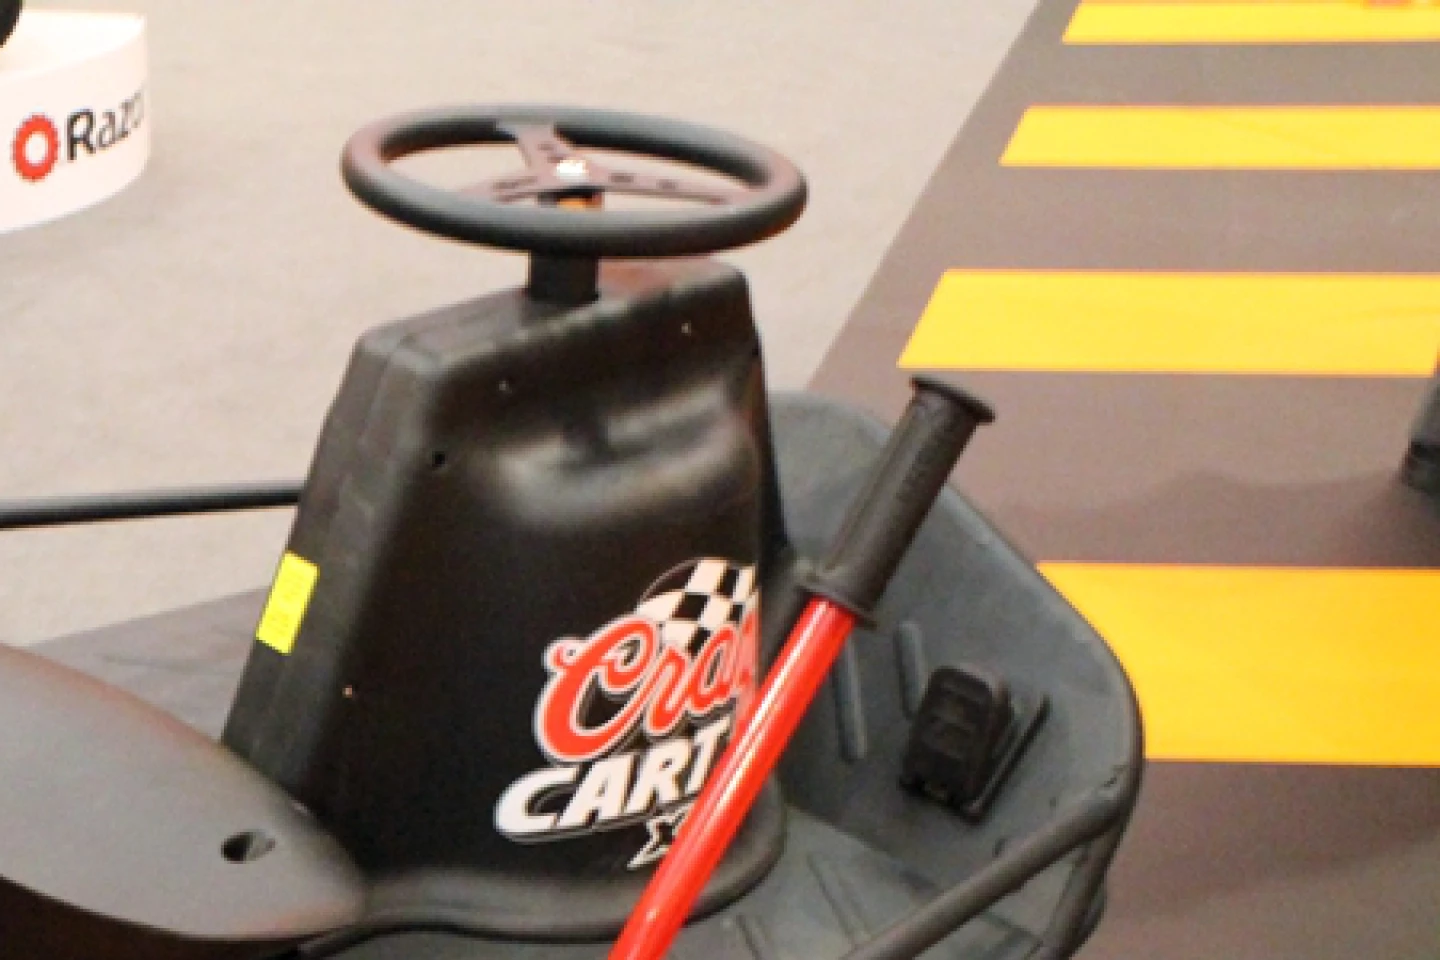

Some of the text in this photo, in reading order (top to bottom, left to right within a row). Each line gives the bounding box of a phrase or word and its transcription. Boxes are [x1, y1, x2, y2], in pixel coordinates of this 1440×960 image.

[65, 91, 146, 162] Razo
[535, 610, 757, 762] Cra
[494, 712, 732, 836] CART
